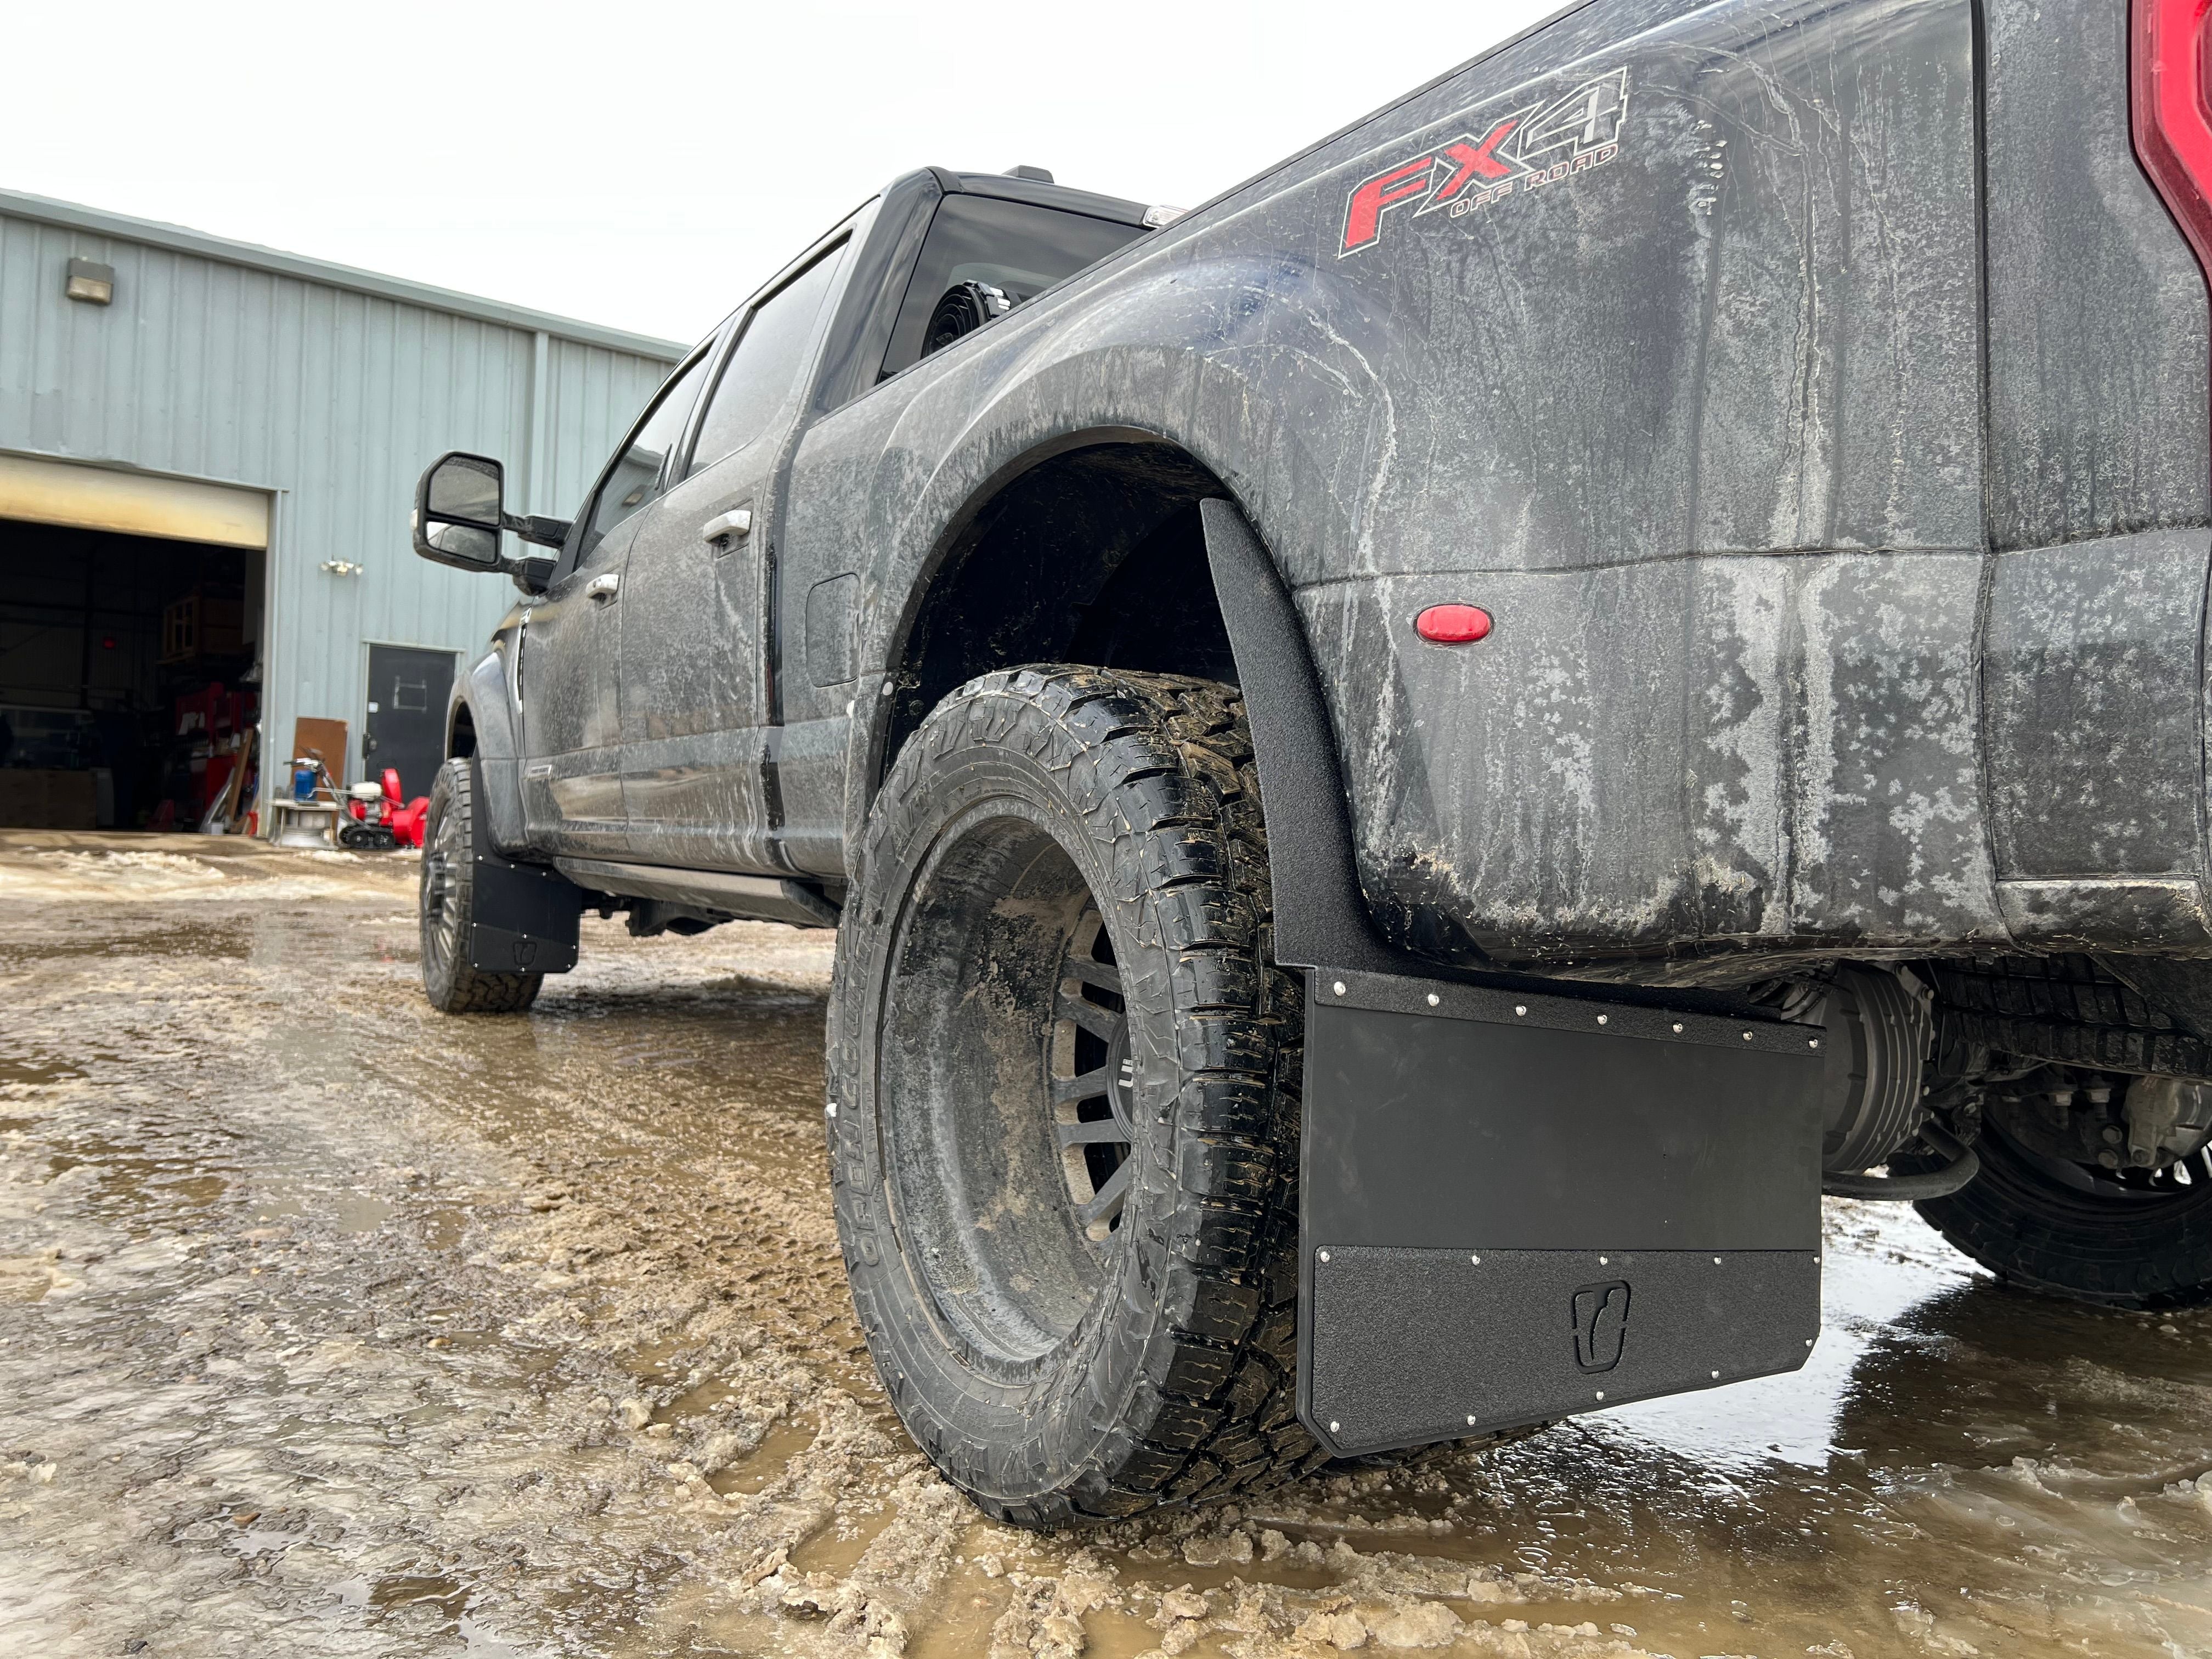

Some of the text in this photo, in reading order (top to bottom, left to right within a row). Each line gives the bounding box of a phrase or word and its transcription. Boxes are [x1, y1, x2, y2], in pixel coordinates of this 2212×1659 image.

[1338, 66, 1628, 259] FX4
[1450, 143, 1619, 218] OFF ROAD
